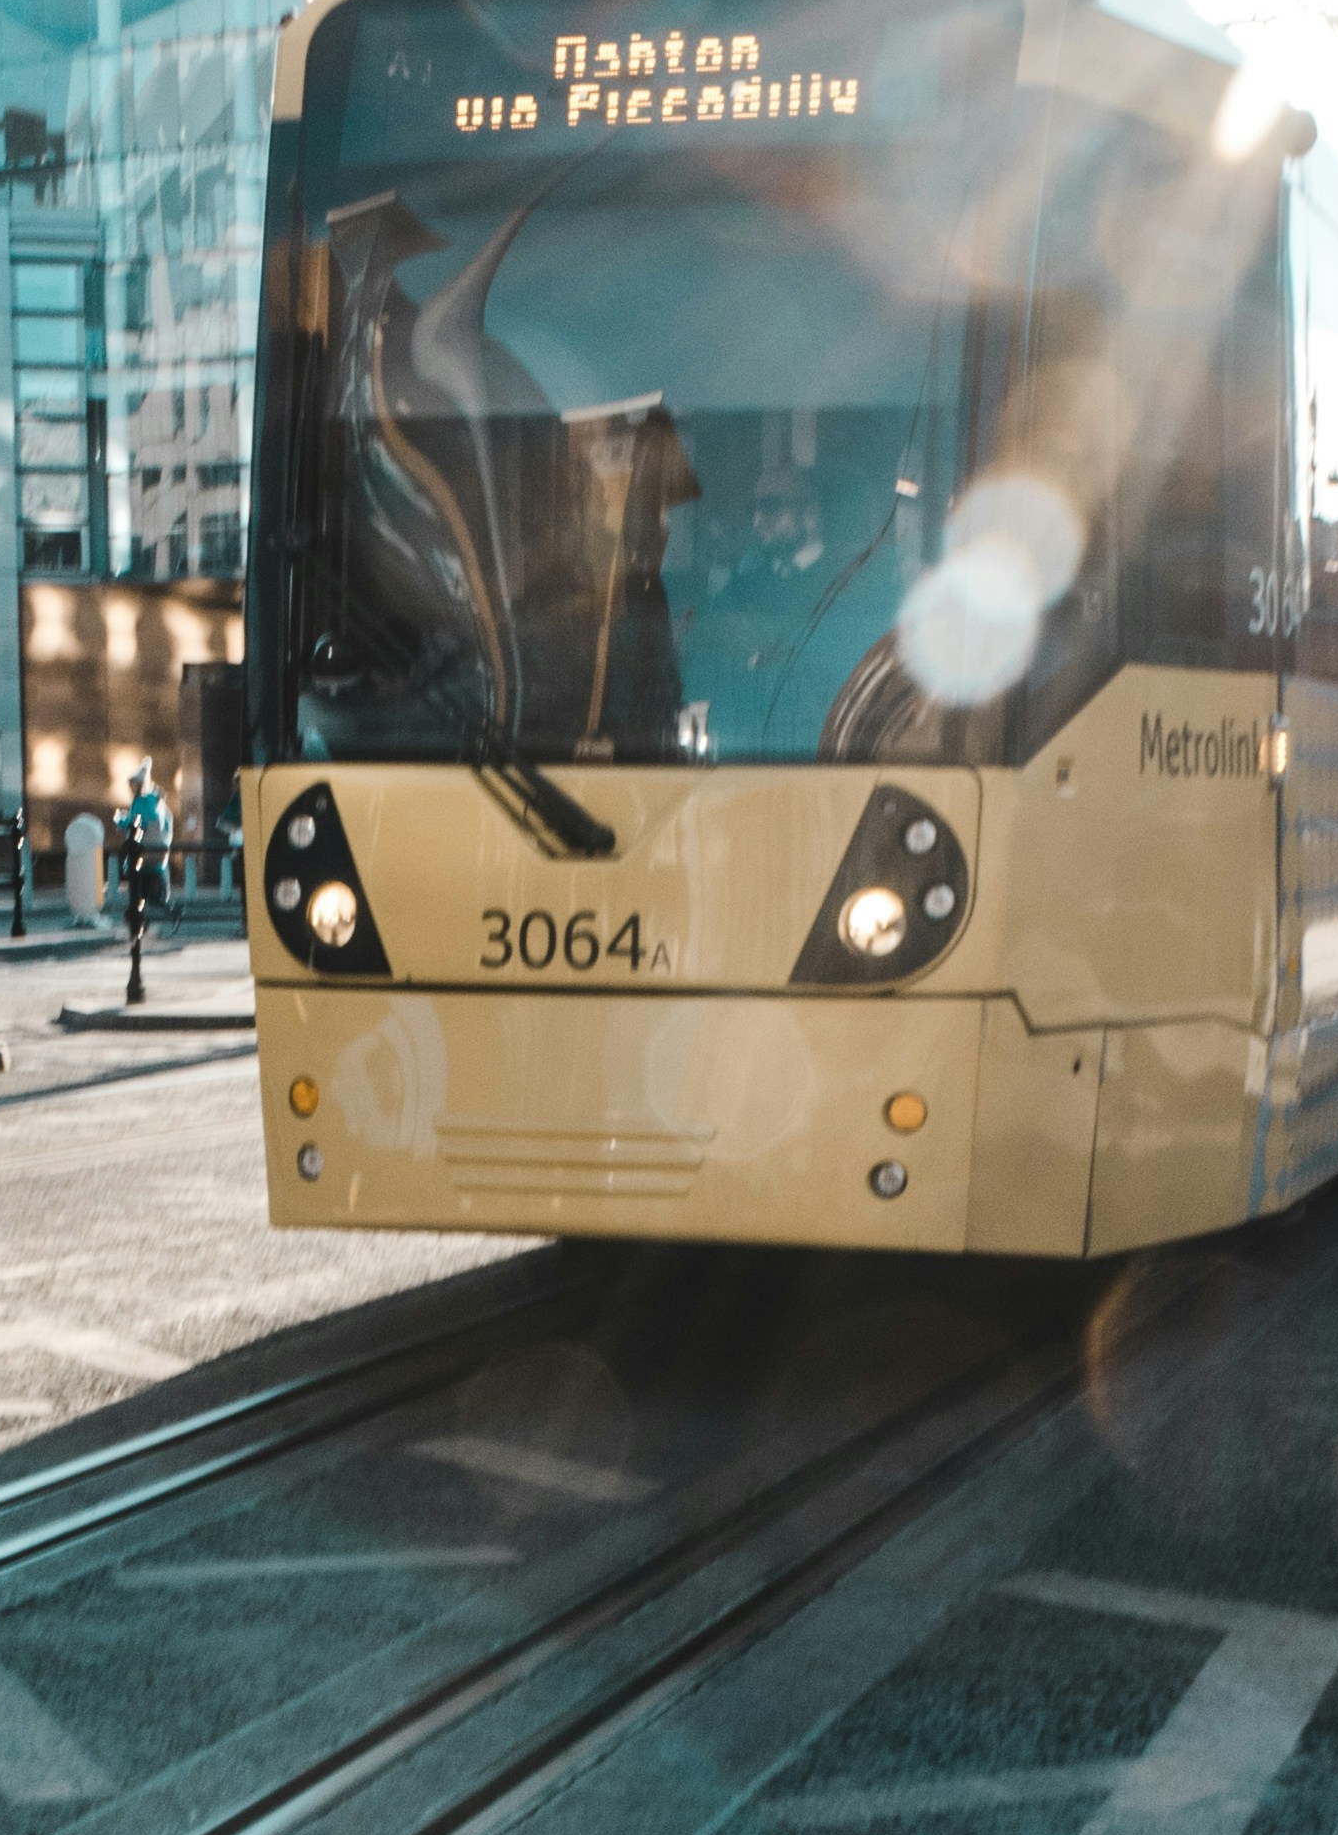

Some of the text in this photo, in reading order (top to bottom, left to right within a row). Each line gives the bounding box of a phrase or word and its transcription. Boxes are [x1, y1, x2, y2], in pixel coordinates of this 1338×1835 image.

[554, 30, 760, 79] Ashton
[455, 72, 859, 132] via Piccadilly
